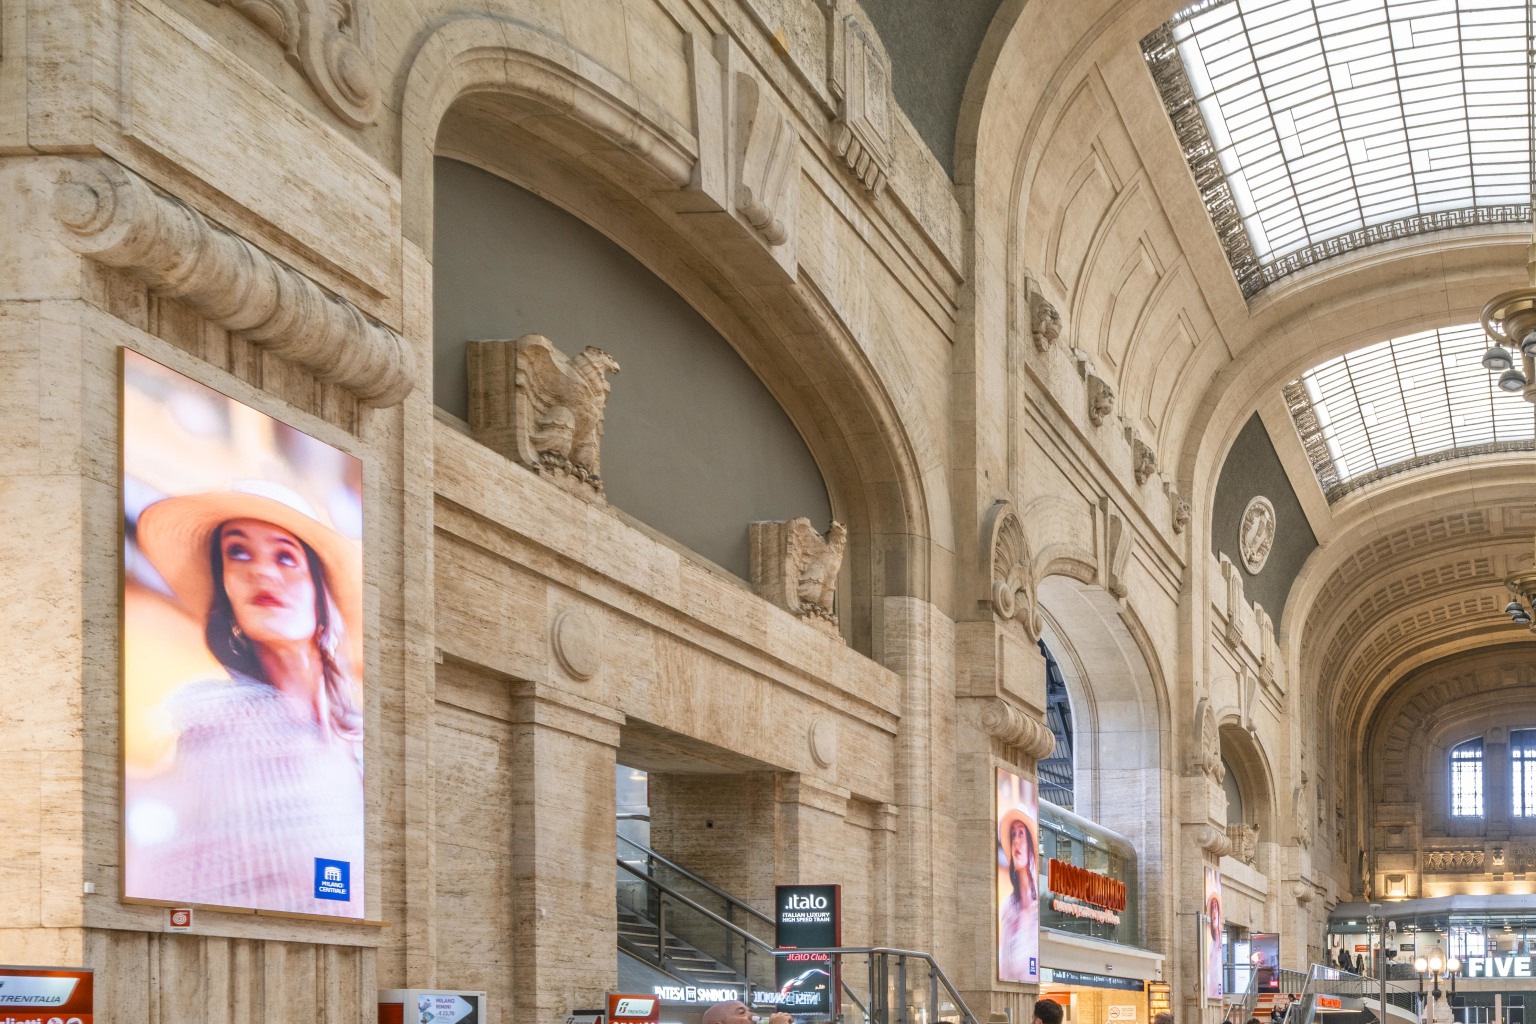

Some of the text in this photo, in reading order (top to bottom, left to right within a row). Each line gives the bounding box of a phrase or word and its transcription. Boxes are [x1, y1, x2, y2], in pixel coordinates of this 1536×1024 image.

[321, 881, 344, 889] MILANO
[318, 886, 347, 895] CENTRALE
[1467, 956, 1531, 977] FIVE
[0, 995, 61, 1003] TRENITALIA
